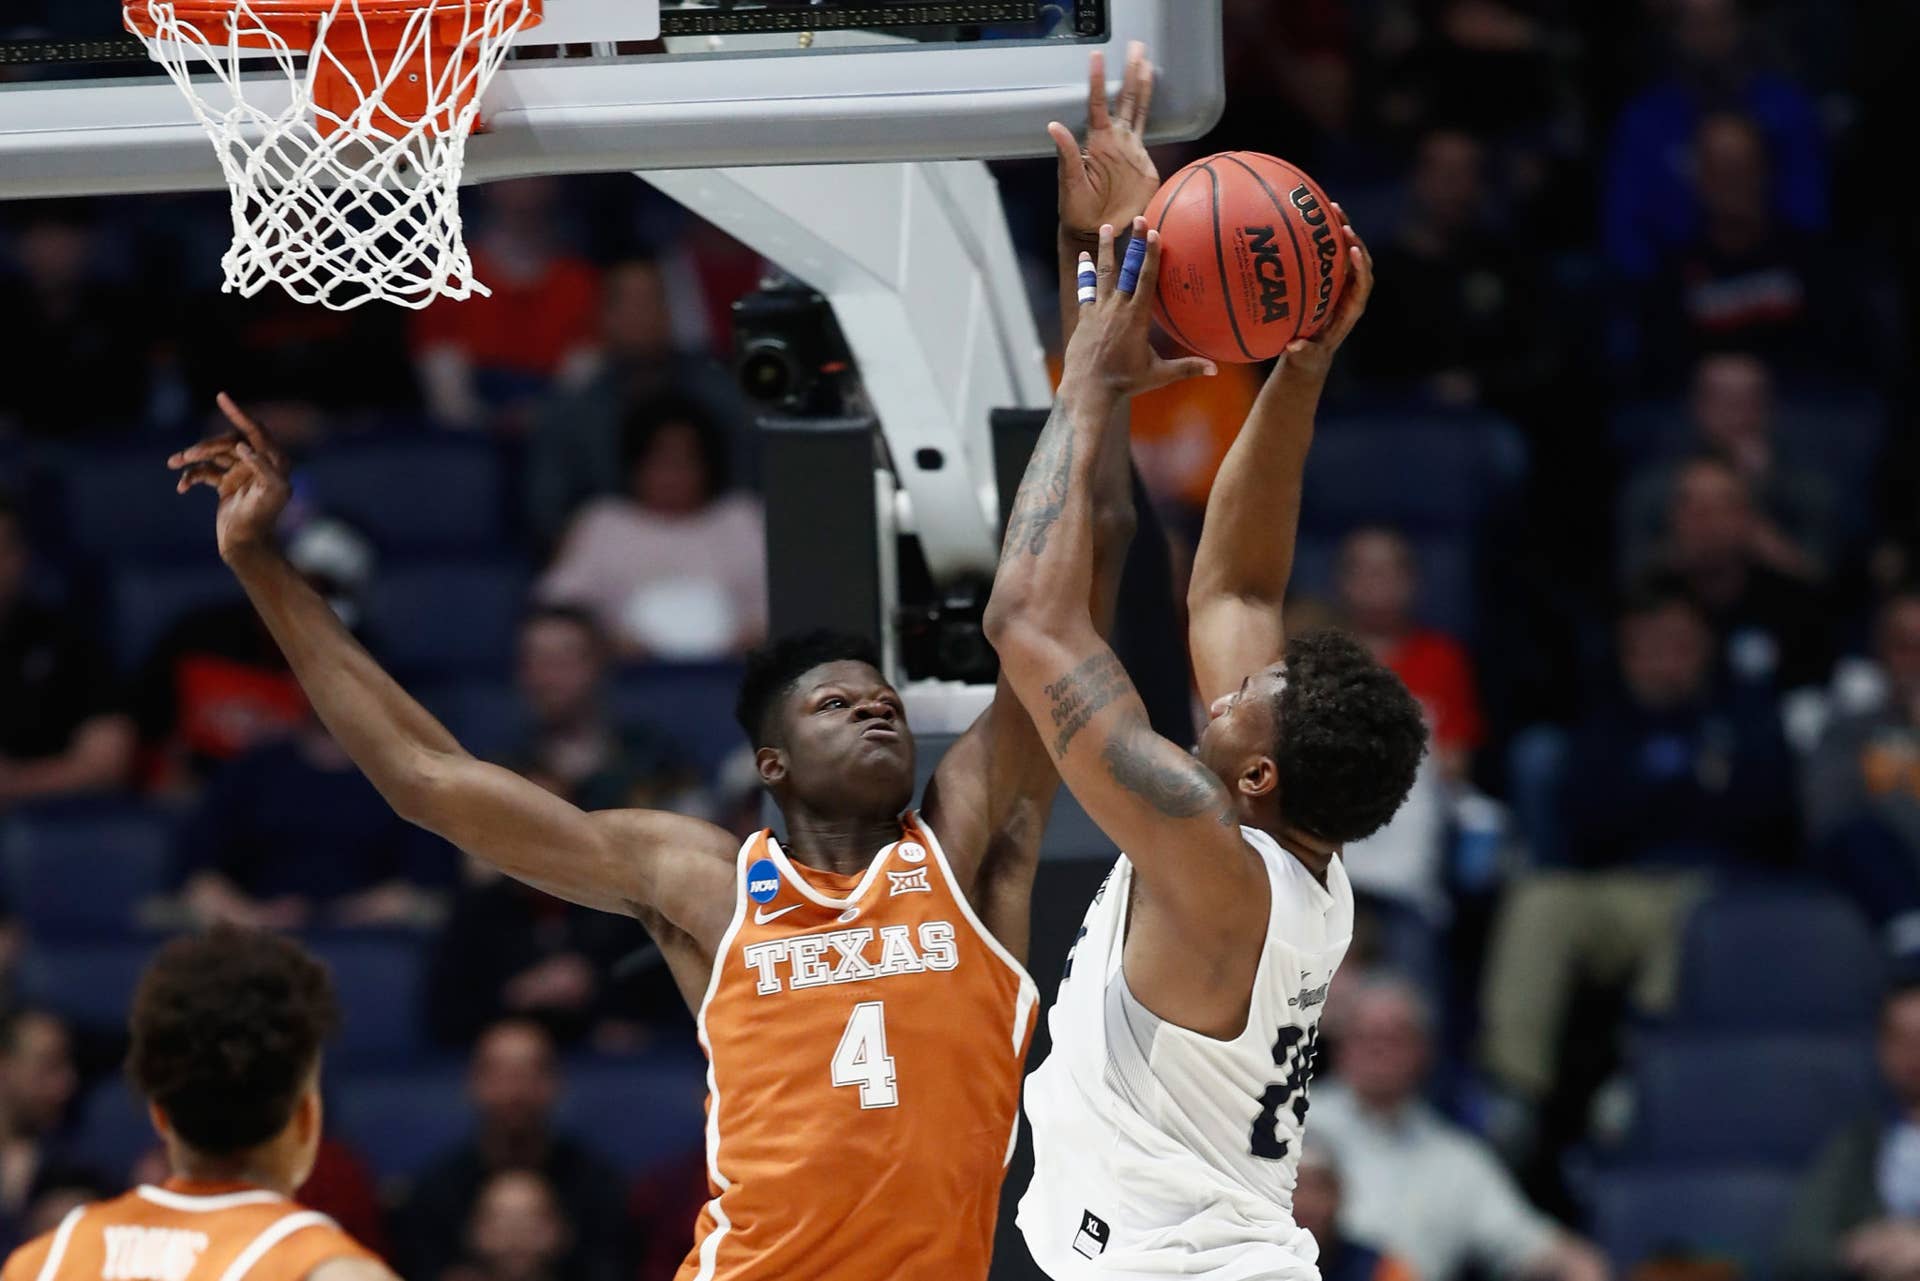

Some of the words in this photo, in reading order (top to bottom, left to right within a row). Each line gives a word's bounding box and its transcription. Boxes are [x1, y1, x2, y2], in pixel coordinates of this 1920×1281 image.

[1245, 225, 1289, 324] NCAA
[1289, 182, 1338, 324] Wilson
[749, 879, 779, 893] NCAA
[743, 920, 959, 996] TEXAS
[830, 1000, 899, 1110] 4
[1085, 1216, 1101, 1237] XL
